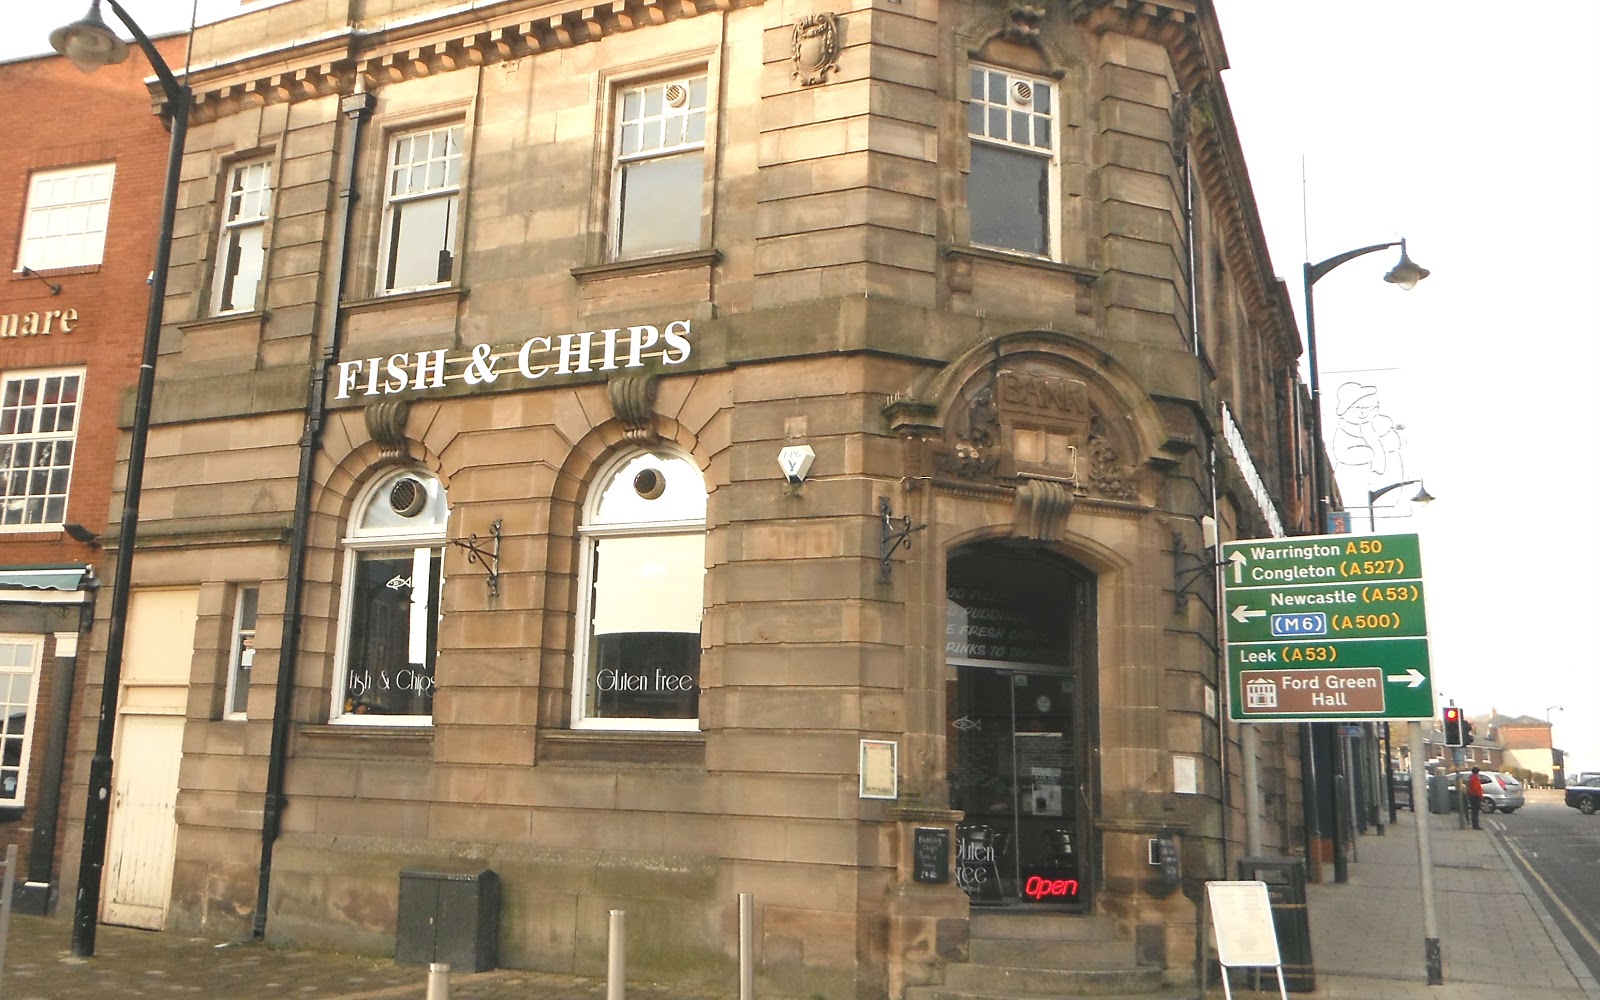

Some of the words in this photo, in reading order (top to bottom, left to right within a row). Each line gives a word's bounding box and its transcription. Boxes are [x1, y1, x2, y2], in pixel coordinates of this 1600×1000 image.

[334, 348, 449, 401] FISH
[462, 343, 501, 386] &
[517, 319, 692, 380] CHIPS
[1003, 375, 1085, 414] BANK
[1251, 544, 1340, 561] Warrington
[1252, 564, 1335, 582] Congleton
[1340, 558, 1405, 578] (A527)
[1271, 589, 1357, 606] Newcastle
[1362, 585, 1419, 604] (A53)
[1275, 615, 1323, 633] (M6)
[1332, 613, 1401, 632] (A500)
[1240, 649, 1277, 662] Leek
[1282, 645, 1337, 663] (A53)
[349, 669, 372, 697] Fish
[378, 669, 390, 690] &
[596, 668, 648, 691] Gluten
[655, 668, 693, 691] Free
[1282, 675, 1320, 690] Ford
[1325, 674, 1377, 689] Green
[1312, 691, 1348, 706] Hall
[957, 867, 987, 884] ree
[1025, 875, 1079, 900] Open
